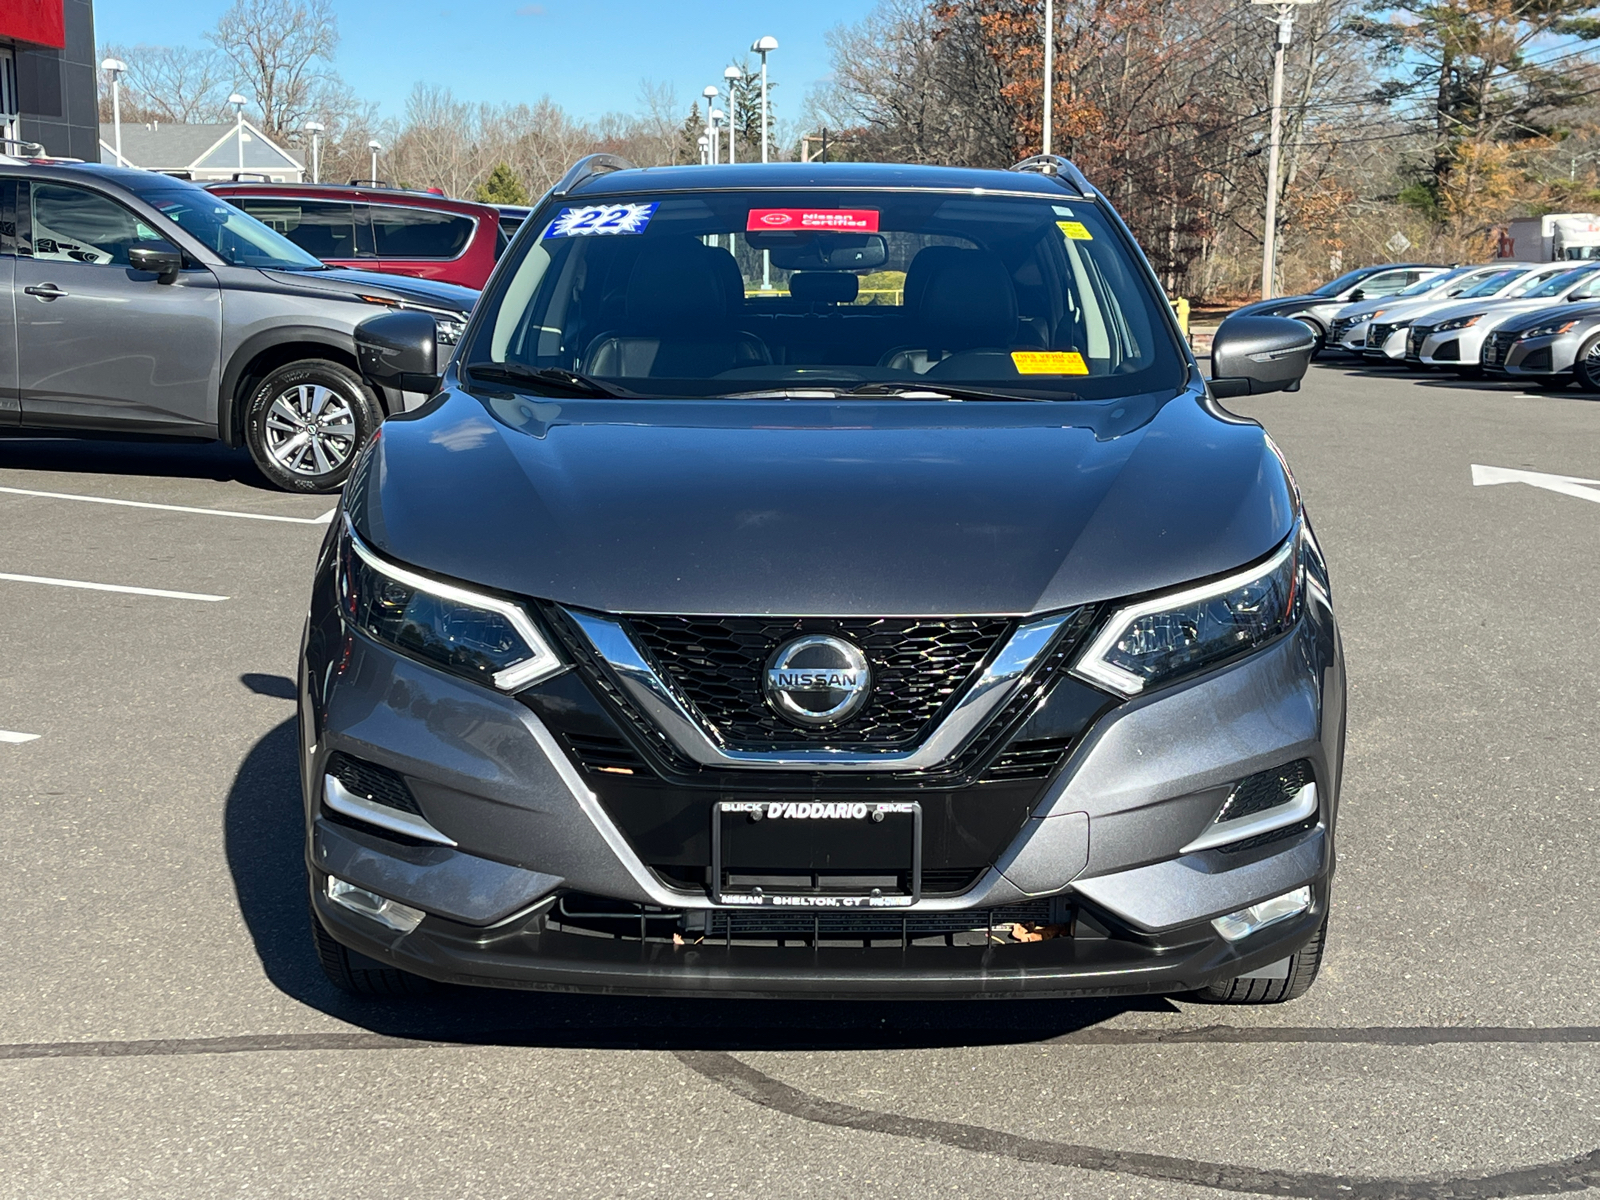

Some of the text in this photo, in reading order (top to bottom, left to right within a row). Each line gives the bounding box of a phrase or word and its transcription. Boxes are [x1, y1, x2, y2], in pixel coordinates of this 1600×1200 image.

[570, 209, 630, 229] 22
[801, 219, 867, 227] Certified
[778, 673, 857, 686] NISSAN
[721, 802, 913, 819] BUICK D'ADDARIO GMC
[721, 895, 763, 904] NISSAN
[772, 896, 840, 907] SHELTON,
